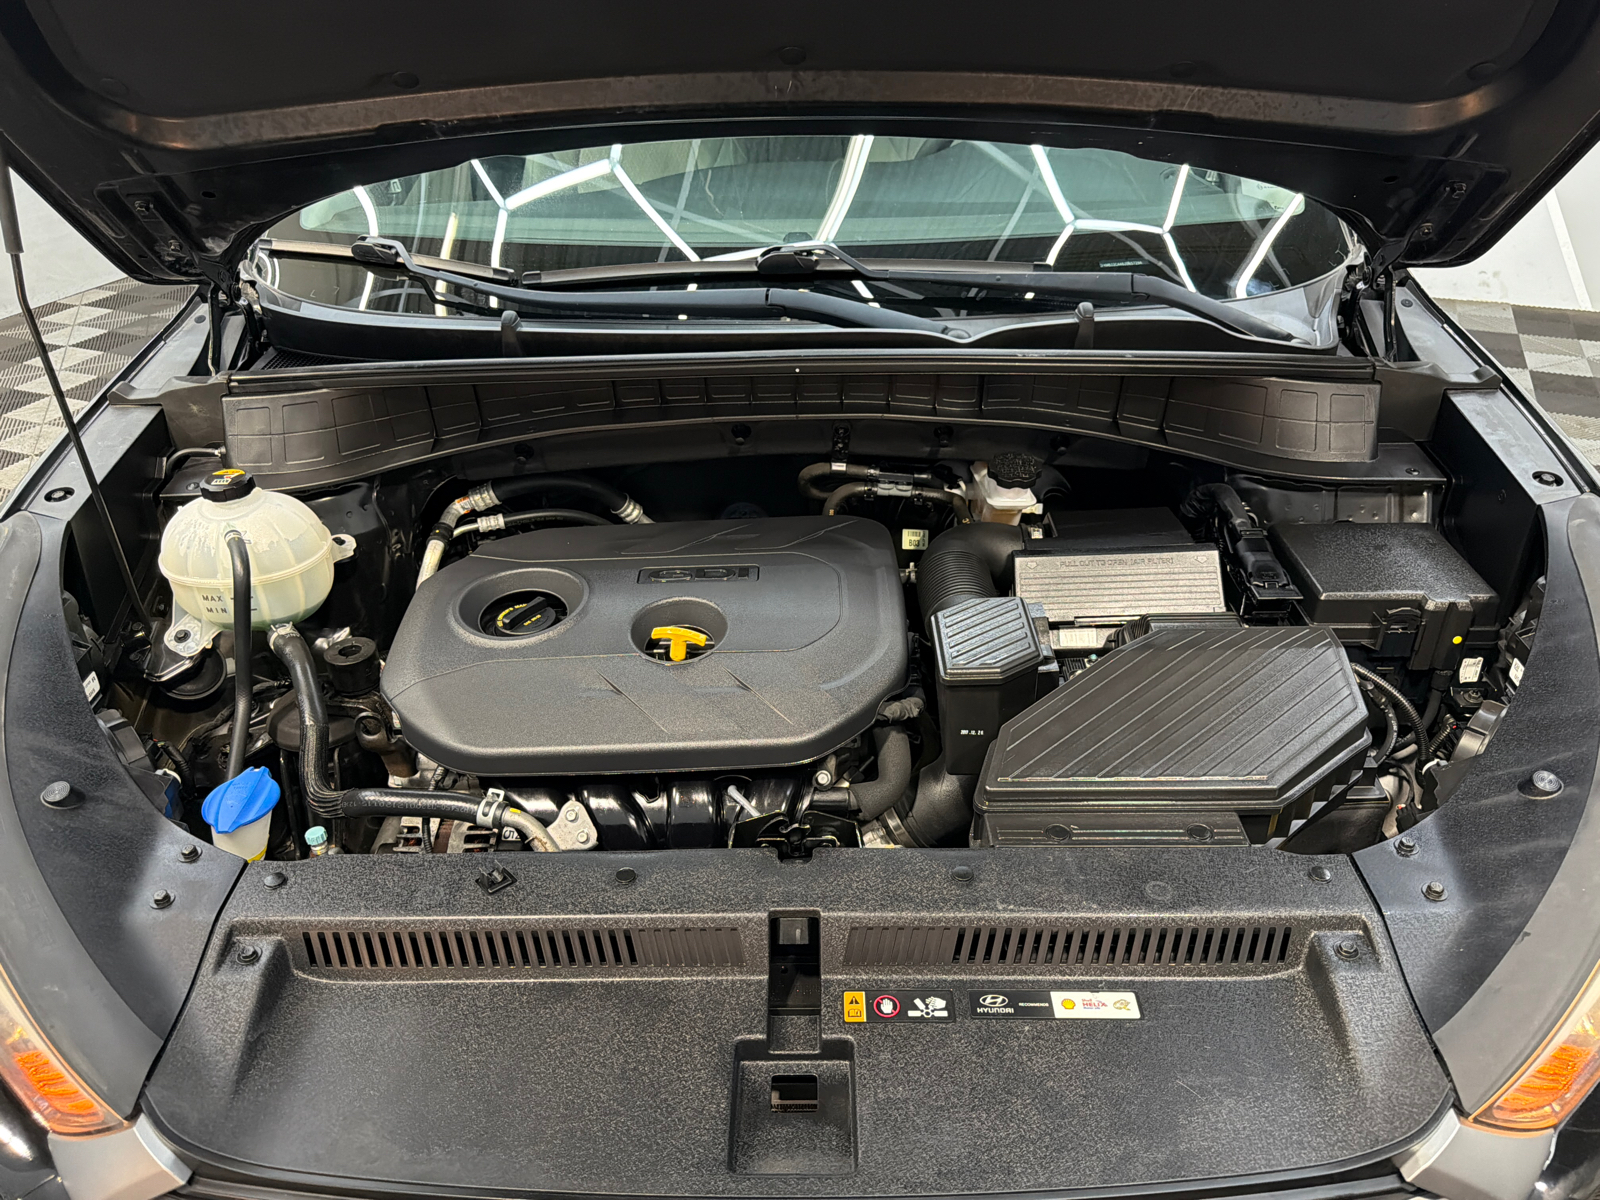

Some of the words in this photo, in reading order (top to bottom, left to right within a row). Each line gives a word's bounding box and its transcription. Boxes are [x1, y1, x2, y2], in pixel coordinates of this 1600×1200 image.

[1059, 559, 1079, 568] PULL
[1080, 559, 1094, 567] OUT
[1096, 559, 1106, 567] TO
[202, 594, 223, 602] MAX
[206, 606, 228, 614] MIN
